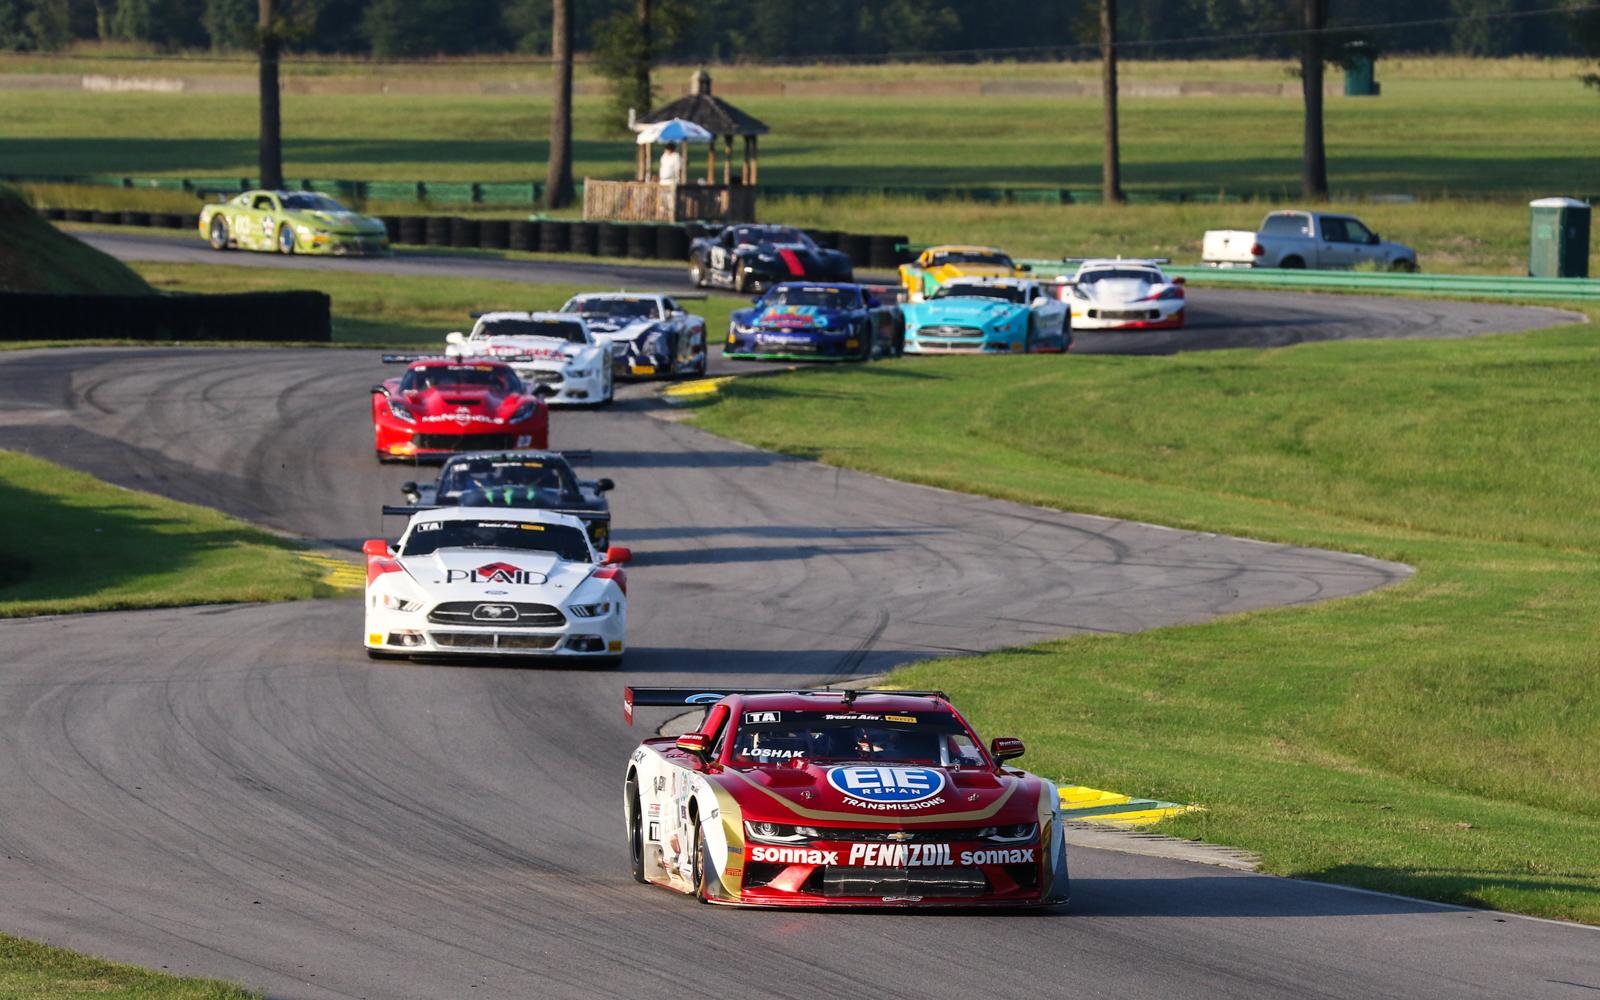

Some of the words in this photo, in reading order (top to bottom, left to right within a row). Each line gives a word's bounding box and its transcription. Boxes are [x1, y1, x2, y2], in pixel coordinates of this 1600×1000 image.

[420, 522, 440, 531] TA
[447, 569, 548, 585] PLAID
[751, 712, 777, 722] TA
[742, 748, 804, 758] LOSHAK
[862, 787, 921, 795] REMAN
[842, 796, 945, 811] TRANSMISSIONS
[752, 847, 838, 865] sonnax
[848, 843, 954, 866] PENNZOIL
[961, 849, 1034, 864] sonnax
